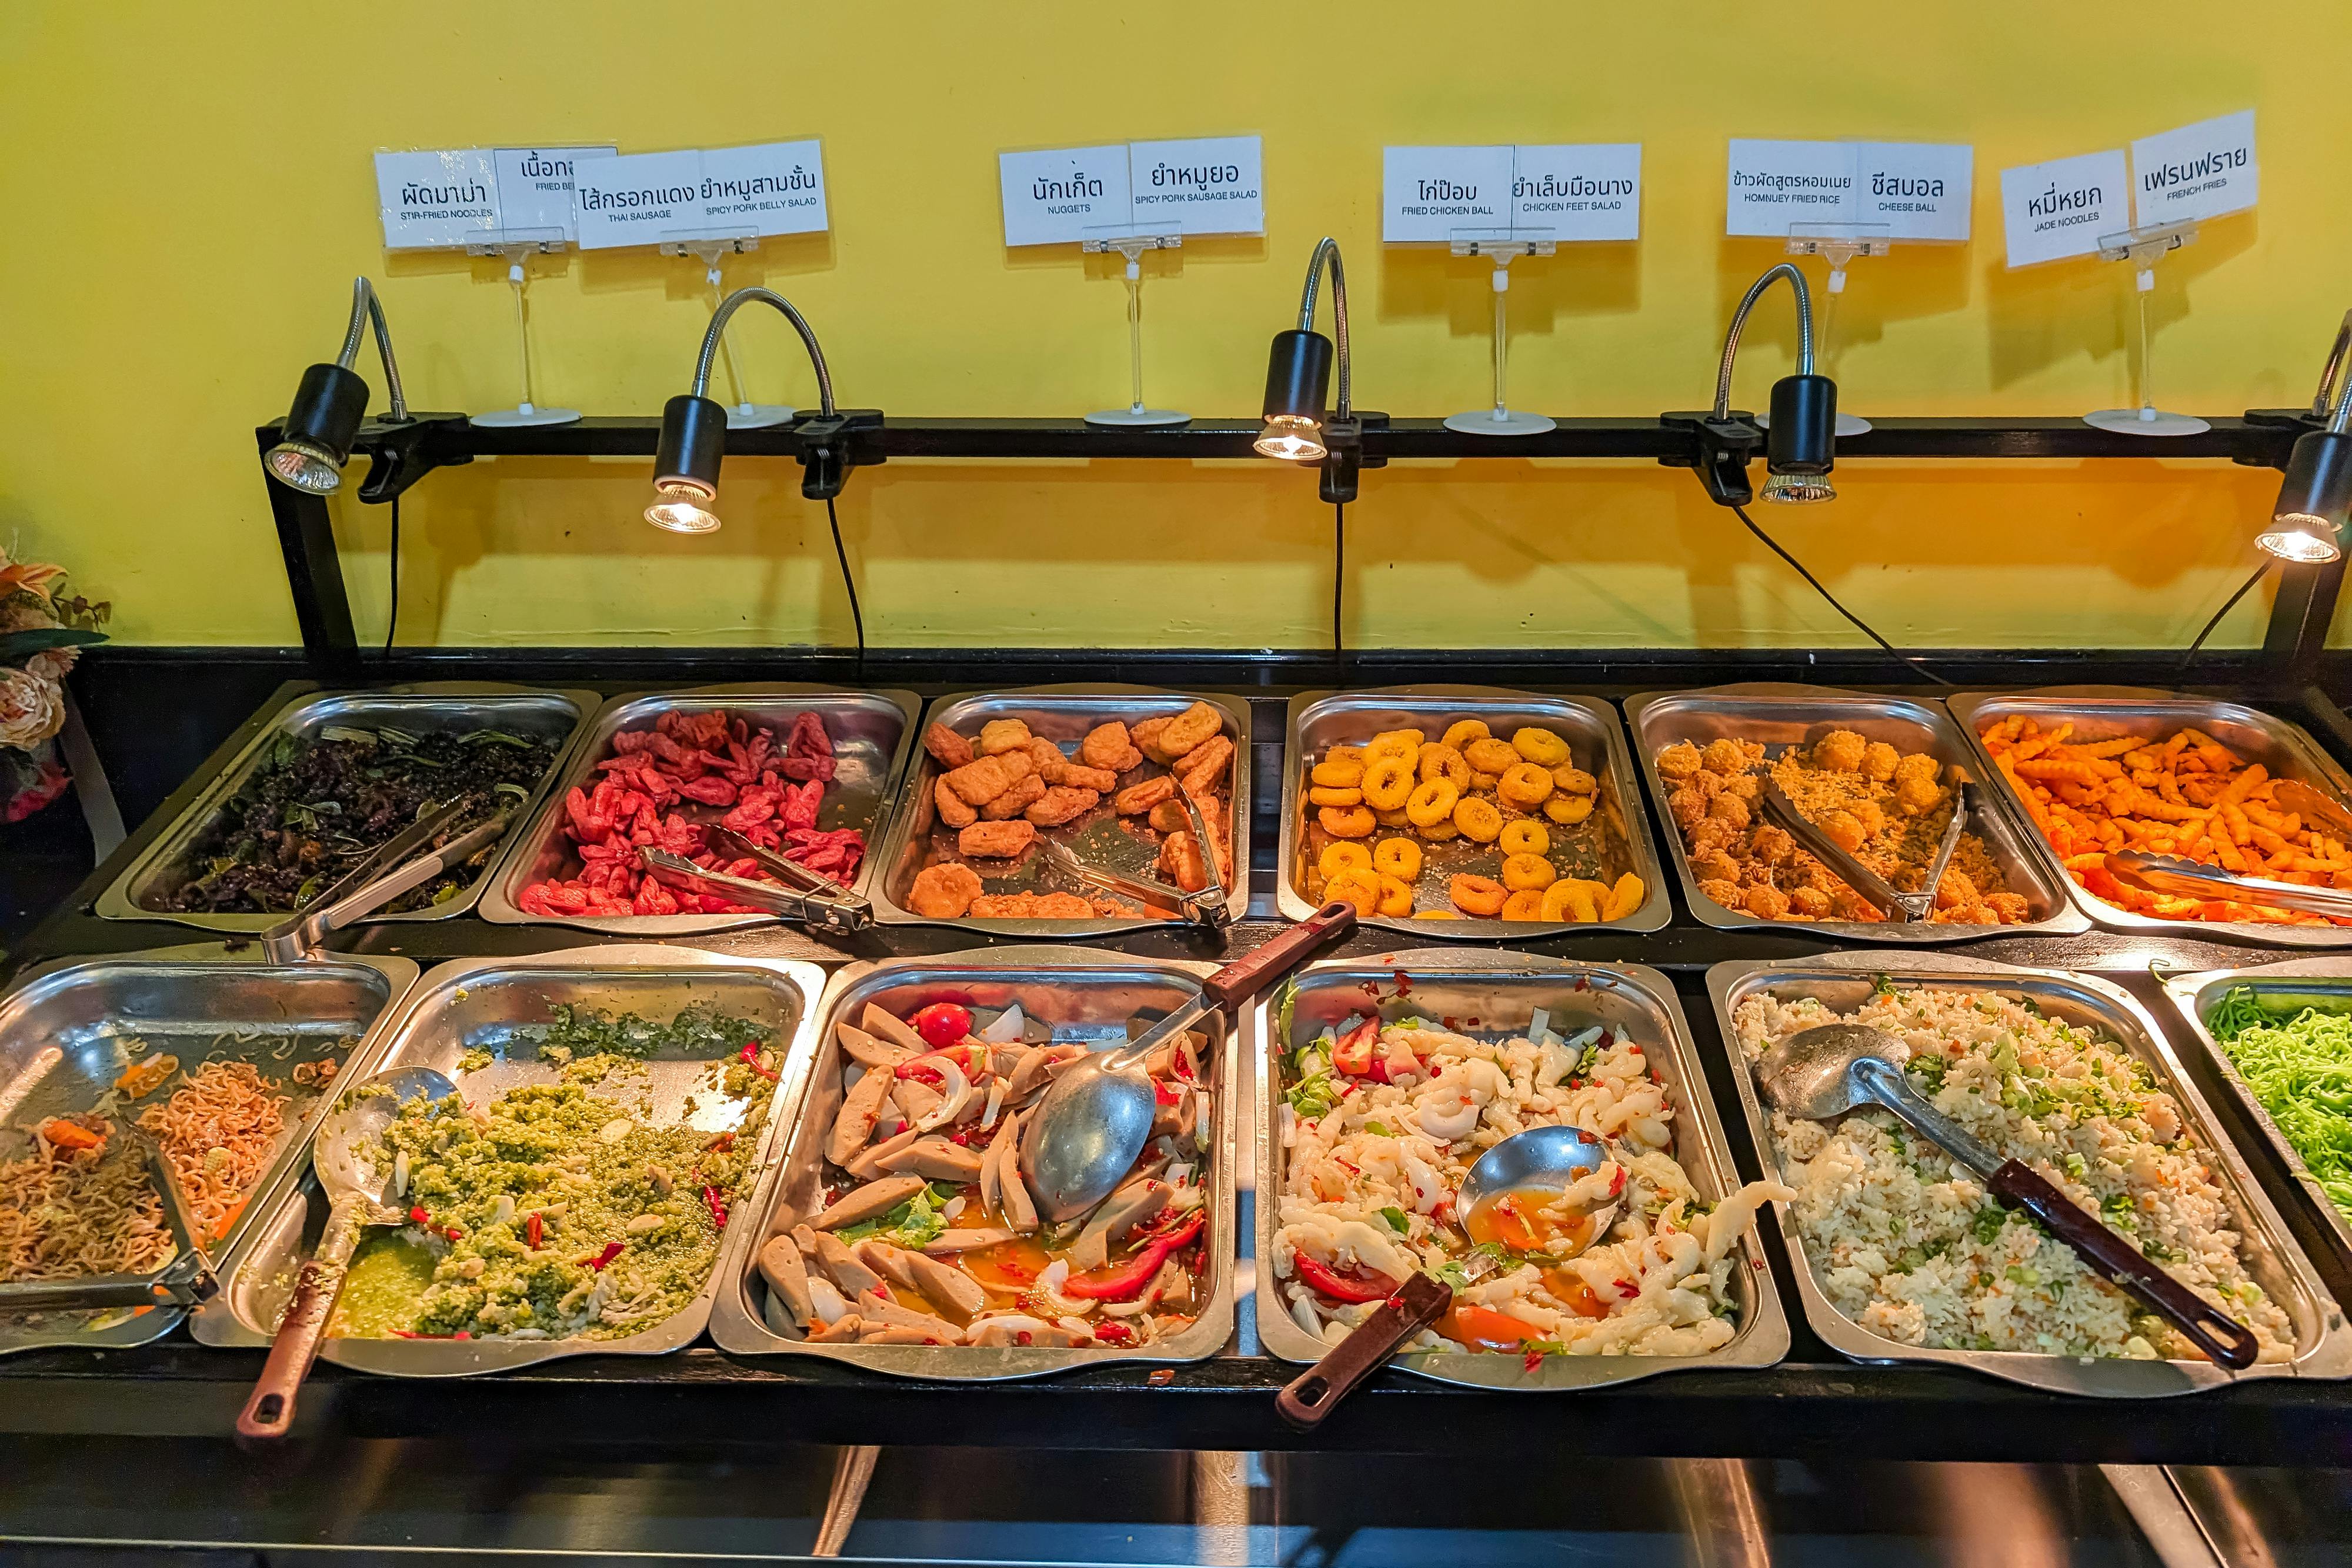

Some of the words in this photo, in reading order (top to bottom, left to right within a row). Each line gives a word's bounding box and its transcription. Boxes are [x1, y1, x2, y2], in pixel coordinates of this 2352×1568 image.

[1152, 162, 1239, 191] ยำหมูยอ
[2144, 148, 2247, 191] เฟรนฟราย
[535, 182, 561, 191] FRIED
[562, 182, 575, 191] BE
[700, 165, 817, 201] ยำหมูสามชั้น
[1417, 179, 1477, 201] ไก่ป๊อบ
[1512, 175, 1633, 197] ยำเล็บมือนาง
[1734, 170, 1851, 191] ข้าวผัดสูตรหอมเนย
[1872, 171, 1943, 197] ชีสบอล
[2167, 185, 2201, 201] FRENCH
[2203, 178, 2227, 192] FRIES
[402, 178, 486, 205] ผัดมาม่า
[579, 186, 695, 212] ไส้กรอกแดง
[1135, 195, 1160, 204] SPICY
[1162, 194, 1186, 203] PORK
[1187, 191, 1228, 202] SAUSAGE
[1229, 190, 1257, 199] SALAD
[1744, 193, 1790, 203] HOMNUEY
[1791, 194, 1817, 203] FRIED
[1819, 195, 1840, 204] RICE
[2029, 182, 2102, 217] หมี่หยก
[400, 210, 449, 221] STIR-FRIED
[450, 208, 493, 218] NOODLES
[608, 213, 628, 223] THAI
[630, 209, 672, 221] SAUSAGE
[706, 205, 732, 216] SPICY
[733, 203, 758, 213] PORK
[759, 200, 786, 211] BELLY
[788, 197, 817, 208] SALAD
[1047, 203, 1091, 215] NUGGETS
[1402, 206, 1428, 215] FRIED
[1429, 206, 1469, 215] CHICKEN
[1472, 206, 1494, 215] BALL
[1523, 202, 1564, 212] CHICKEN
[1566, 202, 1589, 211] FEET
[1591, 201, 1622, 211] SALAD
[1878, 202, 1914, 212] CHEESE
[1915, 203, 1937, 212] BALL
[2034, 220, 2056, 233] JADE
[2058, 212, 2100, 228] NOODLES
